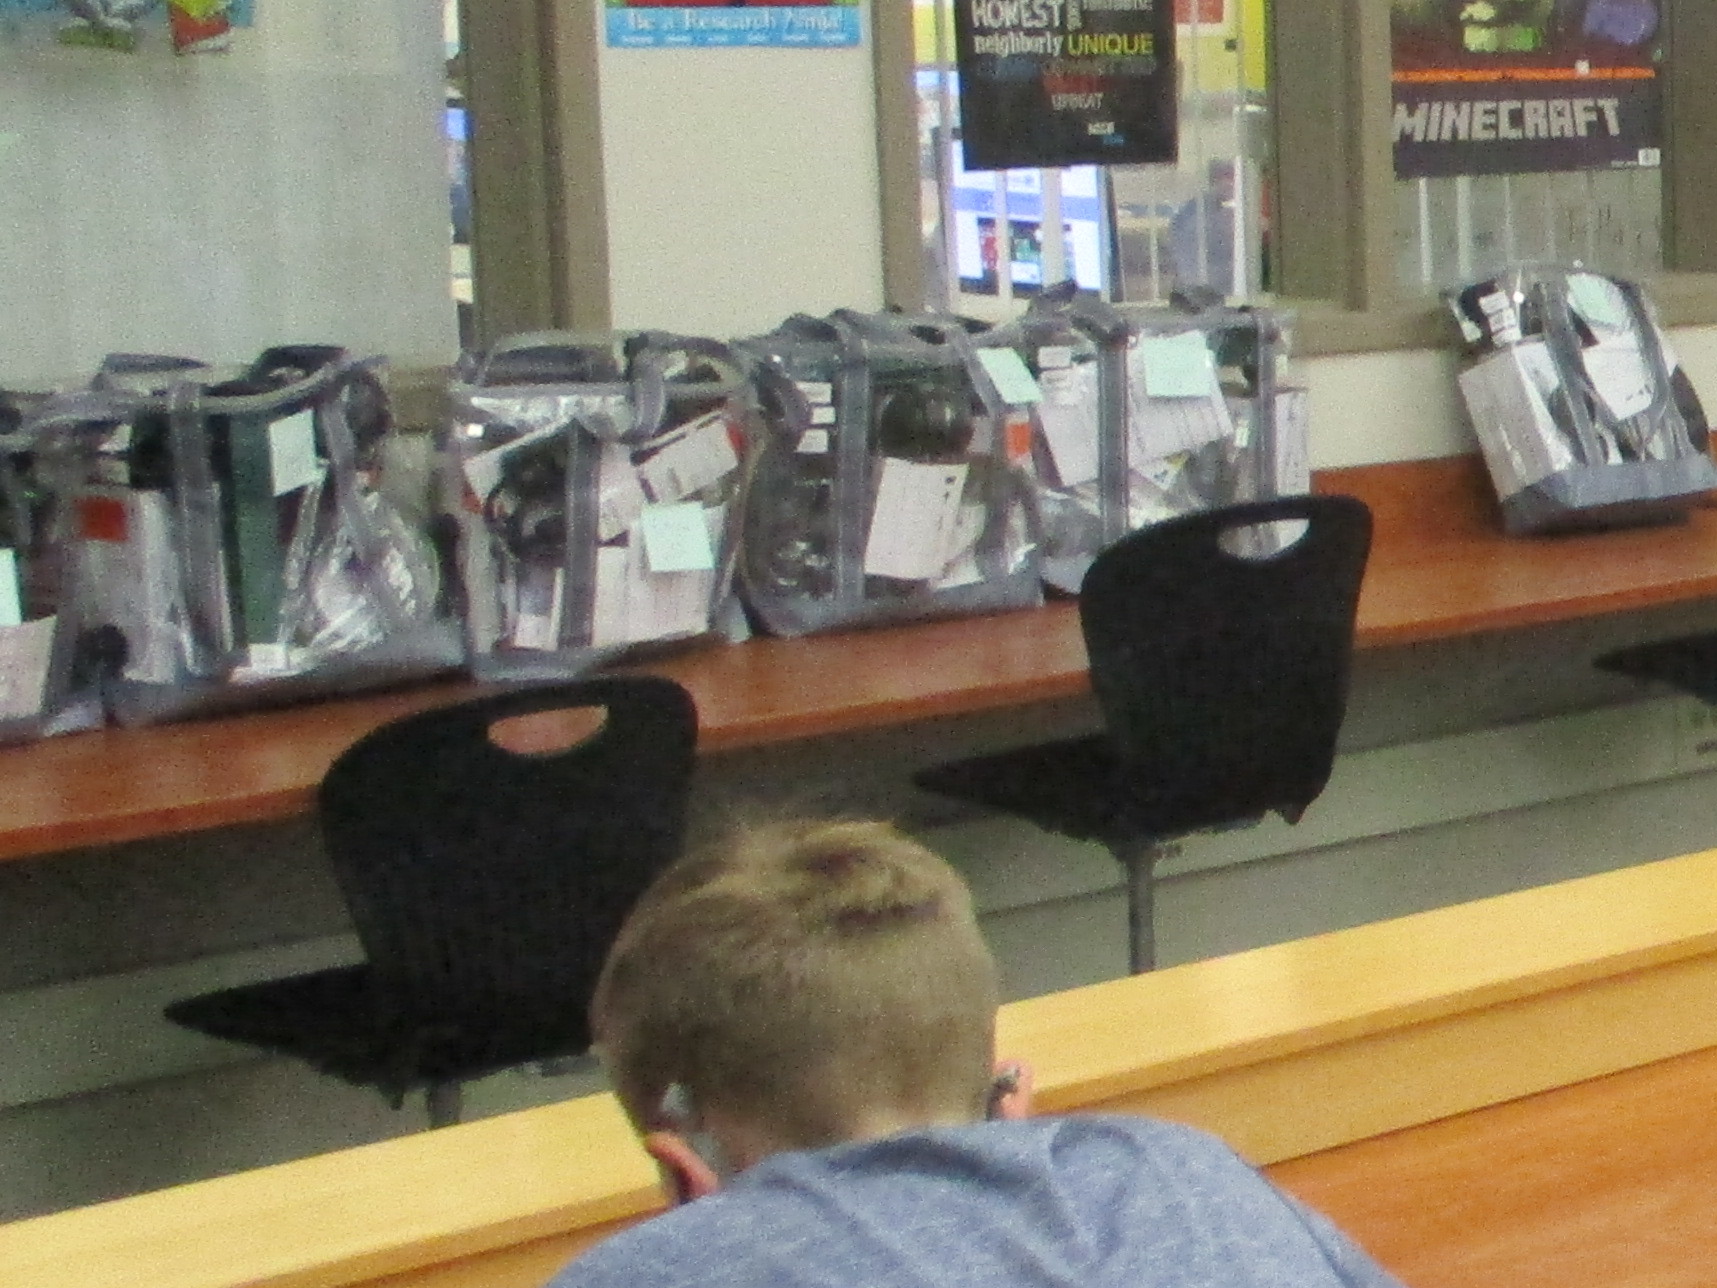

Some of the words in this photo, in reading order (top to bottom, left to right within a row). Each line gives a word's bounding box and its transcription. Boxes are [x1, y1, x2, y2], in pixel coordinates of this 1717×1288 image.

[973, 32, 1064, 58] neighborly
[1067, 32, 1154, 56] UNIQUE
[1393, 97, 1621, 143] MINECRAFT
